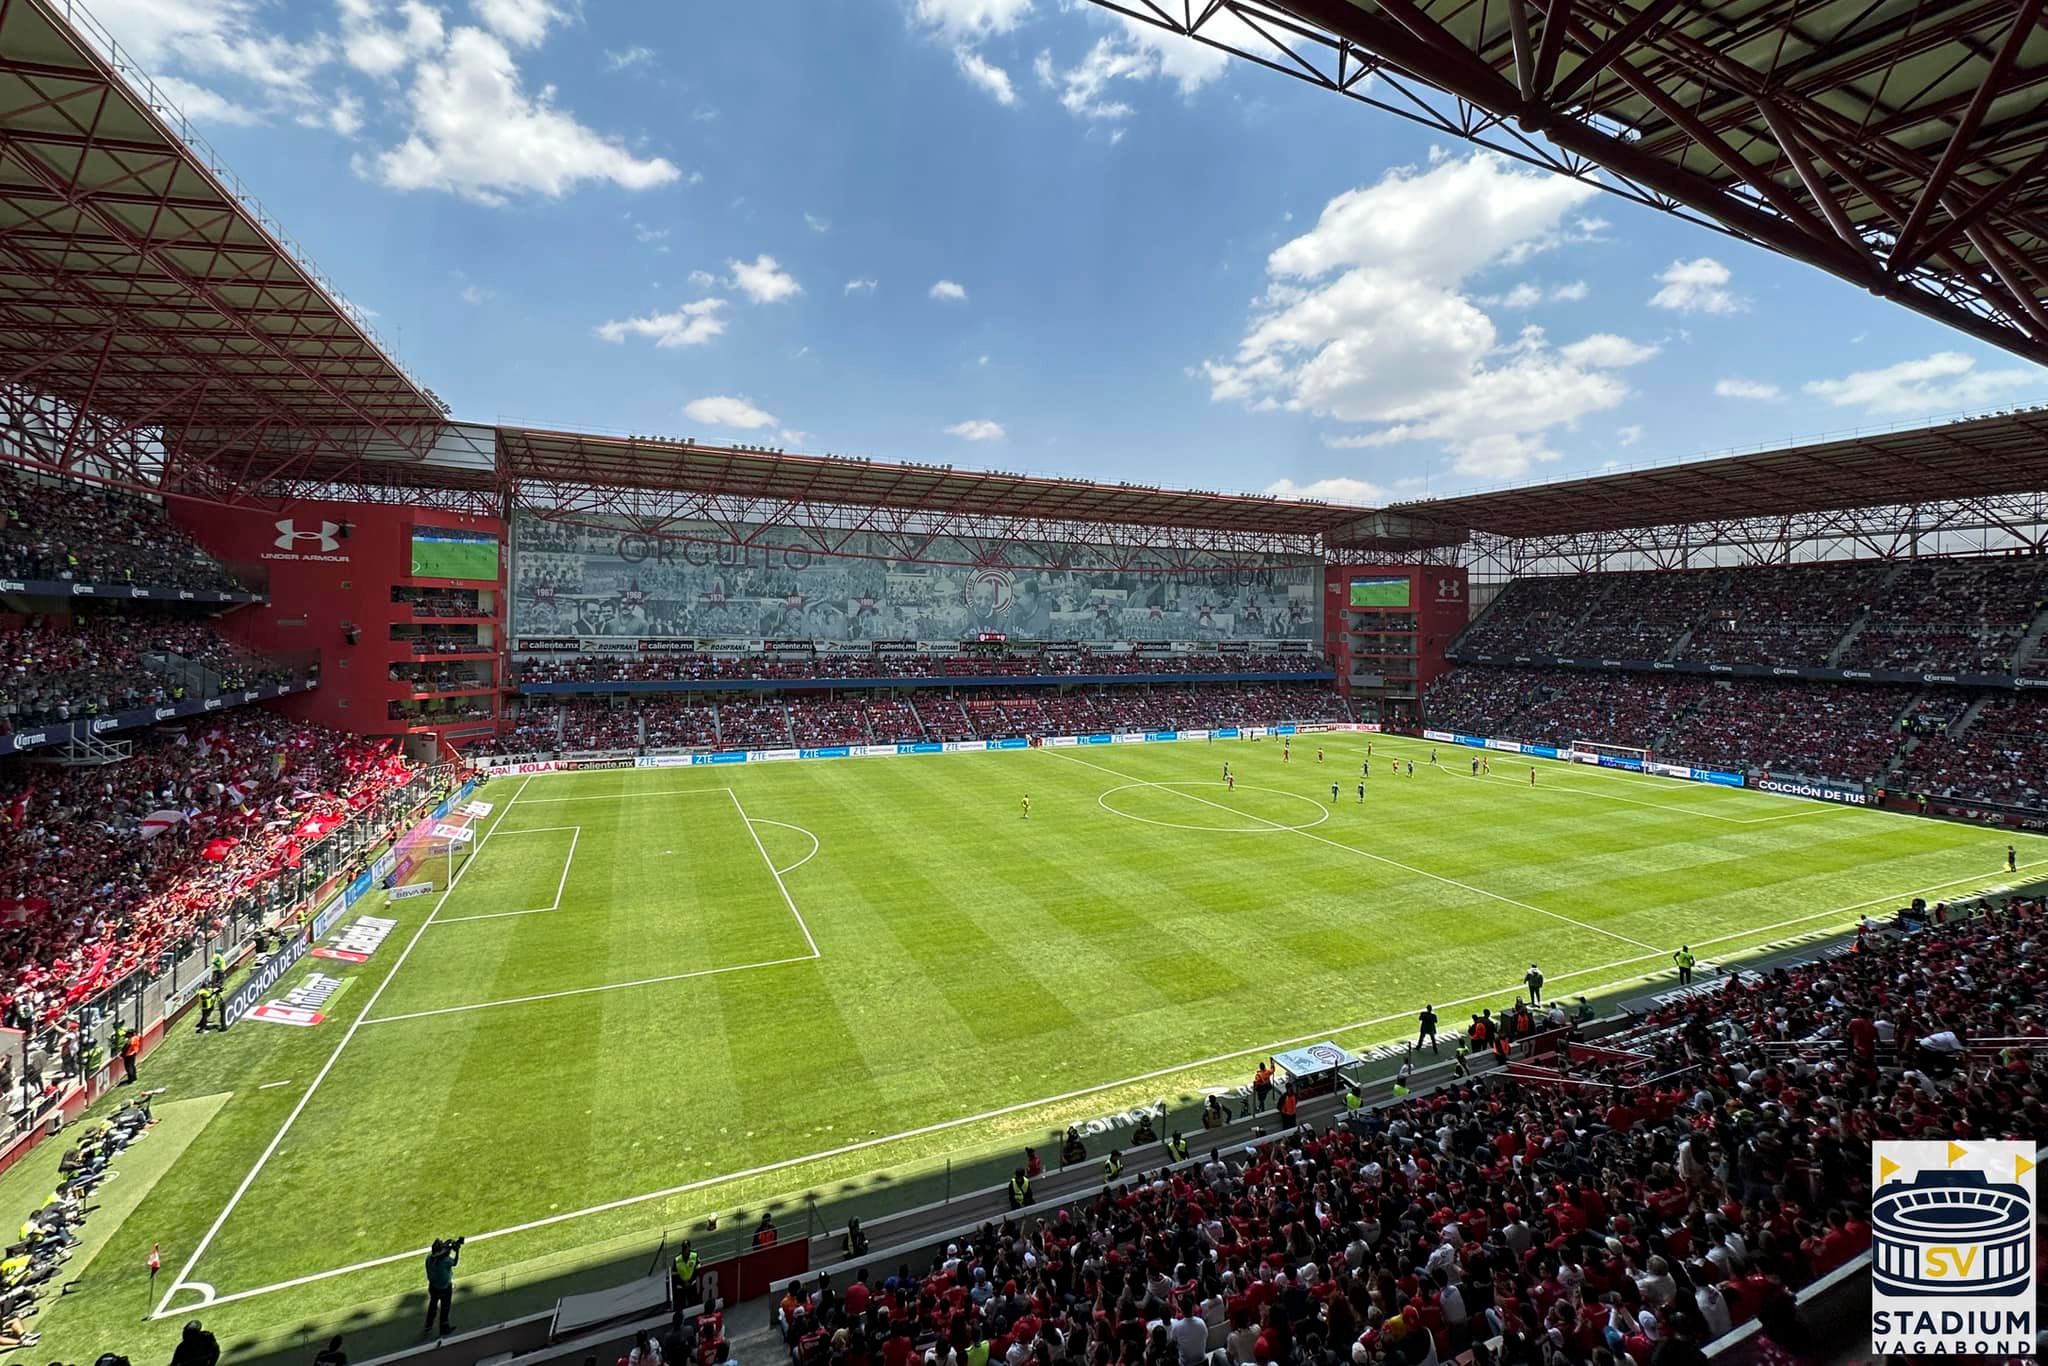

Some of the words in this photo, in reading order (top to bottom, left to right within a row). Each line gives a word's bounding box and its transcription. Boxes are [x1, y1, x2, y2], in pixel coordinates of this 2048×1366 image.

[260, 552, 299, 561] UNDER
[302, 554, 350, 562] ARMOUR
[626, 591, 642, 600] 1968
[528, 639, 579, 650] caliente.mx
[647, 640, 693, 650] caliente.mx
[93, 718, 119, 733] Corona
[13, 732, 46, 750] Corona
[989, 740, 1003, 749] ZTE
[1079, 736, 1091, 744] ZTE
[1455, 735, 1466, 744] ZTE
[853, 746, 868, 755] ZTE
[900, 744, 915, 753] ZTE
[945, 743, 960, 751] ZTE
[1522, 744, 1534, 753] ZTE
[751, 752, 769, 761] ZTE
[803, 749, 820, 758] ZTE
[638, 757, 656, 767] ZTE
[695, 754, 712, 764] ZTE
[519, 762, 552, 774] KOLA
[577, 759, 634, 771] caliente.mx
[1693, 770, 1711, 781] ZTE
[1758, 779, 1822, 798] COLCHÓN
[1824, 789, 1841, 800] DE
[1844, 792, 1866, 804] TUS
[224, 960, 279, 1027] COLCHÓN
[279, 949, 292, 974] DE
